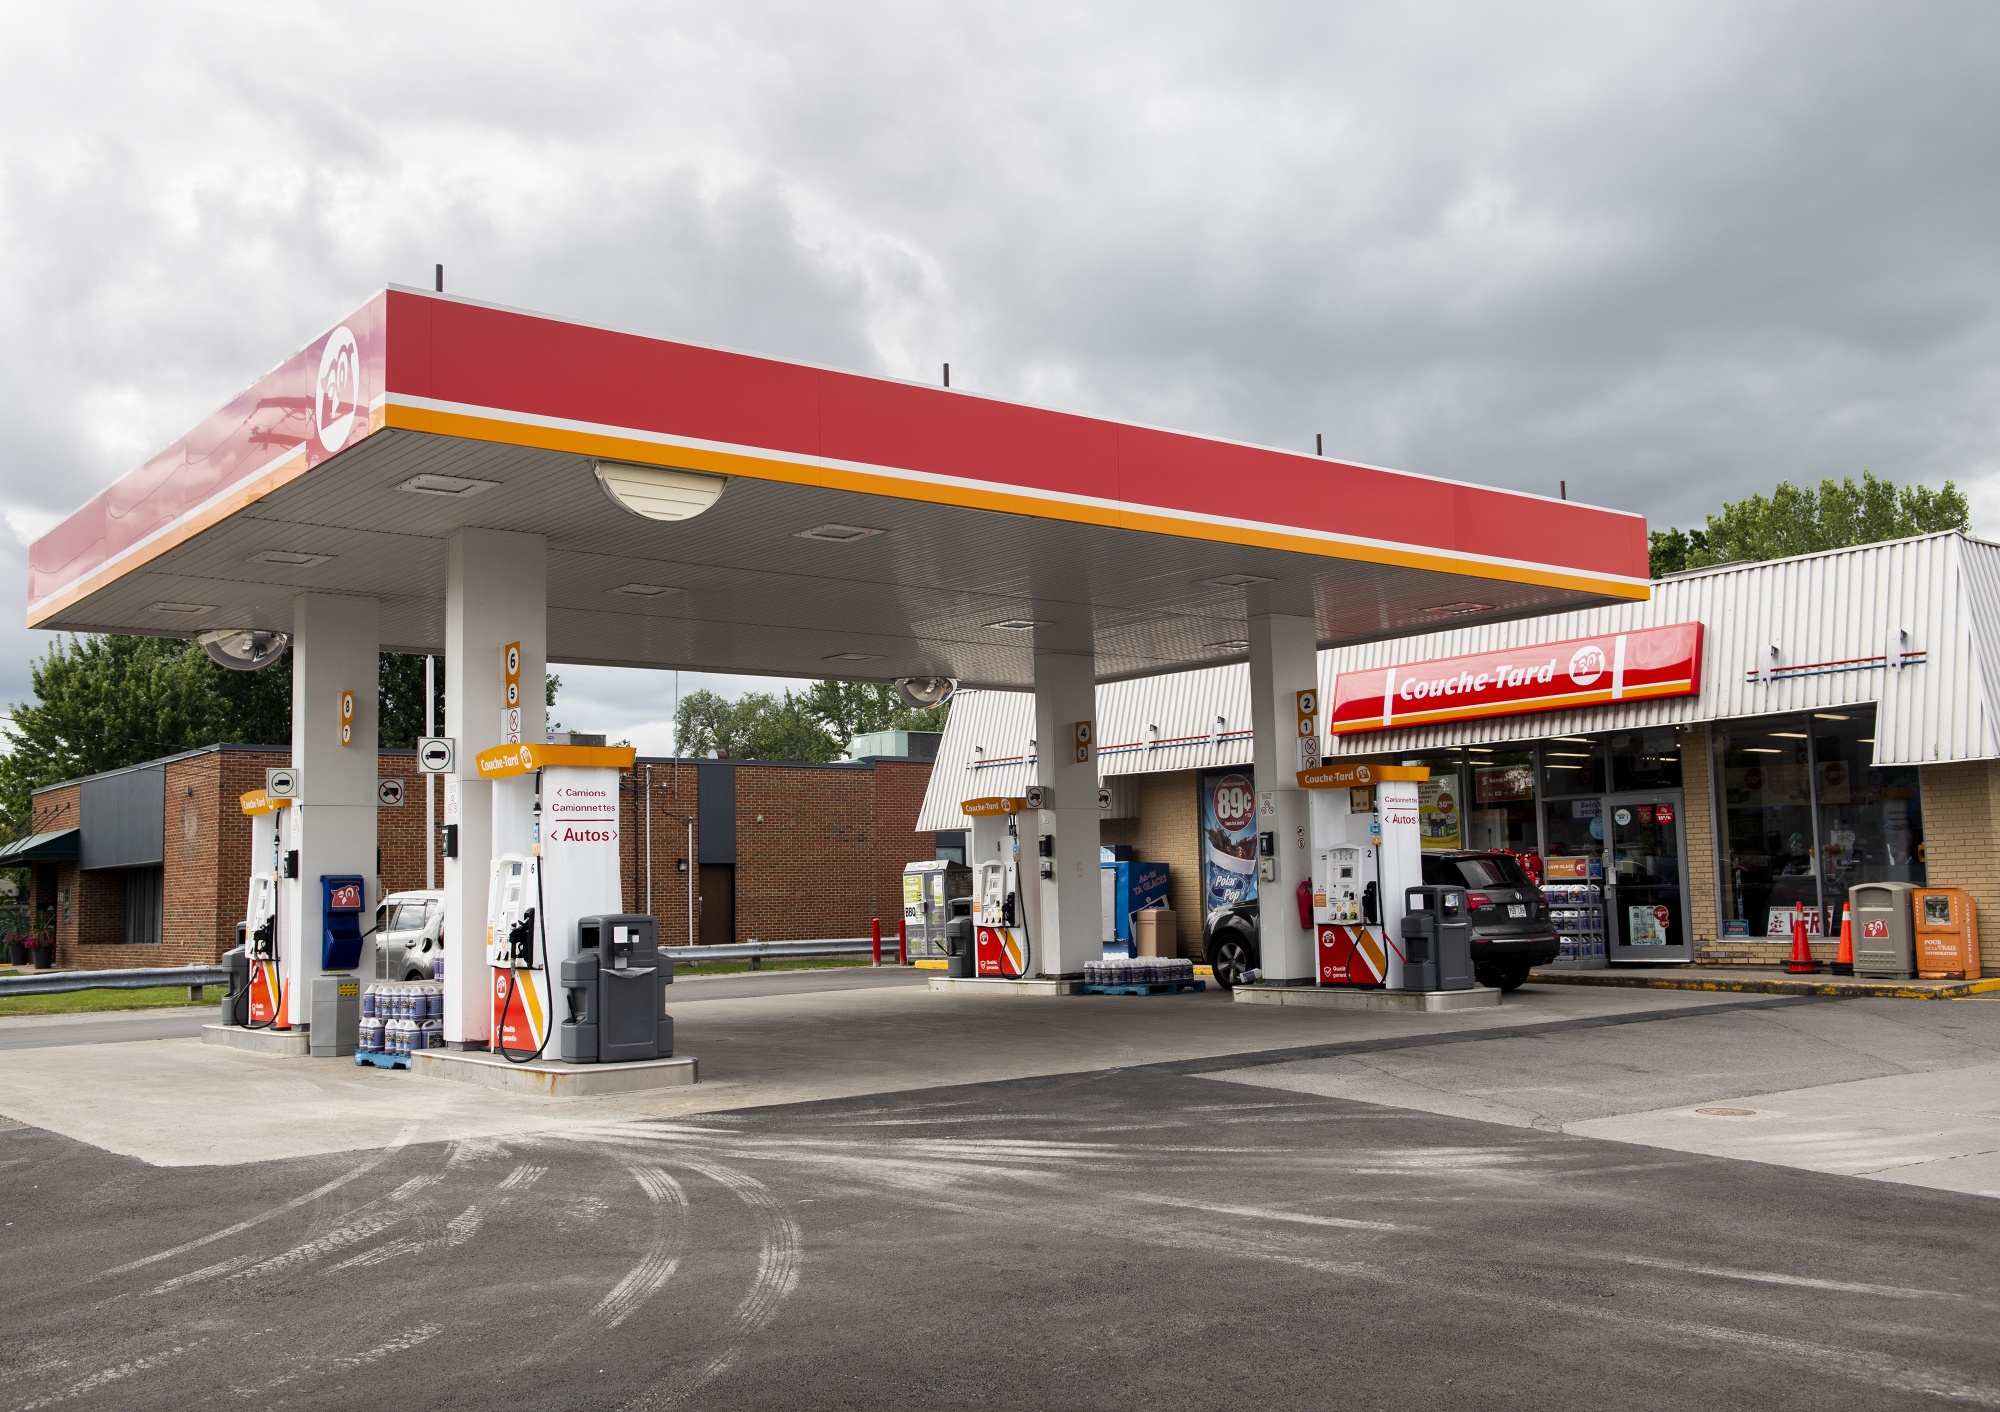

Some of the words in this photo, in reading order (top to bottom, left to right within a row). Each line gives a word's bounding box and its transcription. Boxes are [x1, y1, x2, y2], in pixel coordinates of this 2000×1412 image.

[510, 653, 516, 668] 6
[1400, 658, 1557, 701] Couche-Tard
[510, 688, 515, 699] 5
[345, 700, 350, 713] 8
[1303, 698, 1311, 709] 2
[1304, 722, 1308, 731] 1
[344, 728, 349, 738] 7
[1080, 728, 1087, 738] 4
[1080, 750, 1085, 758] 3
[480, 754, 519, 771] Couche-Tard
[1304, 771, 1354, 784] Couche-Tard
[565, 788, 606, 797] Camions
[243, 797, 265, 809] Couche-Tard
[552, 803, 616, 812] Camionnettes
[965, 802, 999, 812] Couche-Tard
[1217, 787, 1252, 819] 89¢
[1392, 813, 1416, 825] Autos
[563, 828, 609, 842] Autos
[1367, 850, 1372, 858] 2
[531, 863, 535, 874] 6
[1215, 875, 1237, 887] Polar
[1223, 889, 1241, 903] Pop
[905, 907, 916, 917] BBQ
[503, 1025, 516, 1033] Qualité
[503, 1035, 517, 1043] garantie
